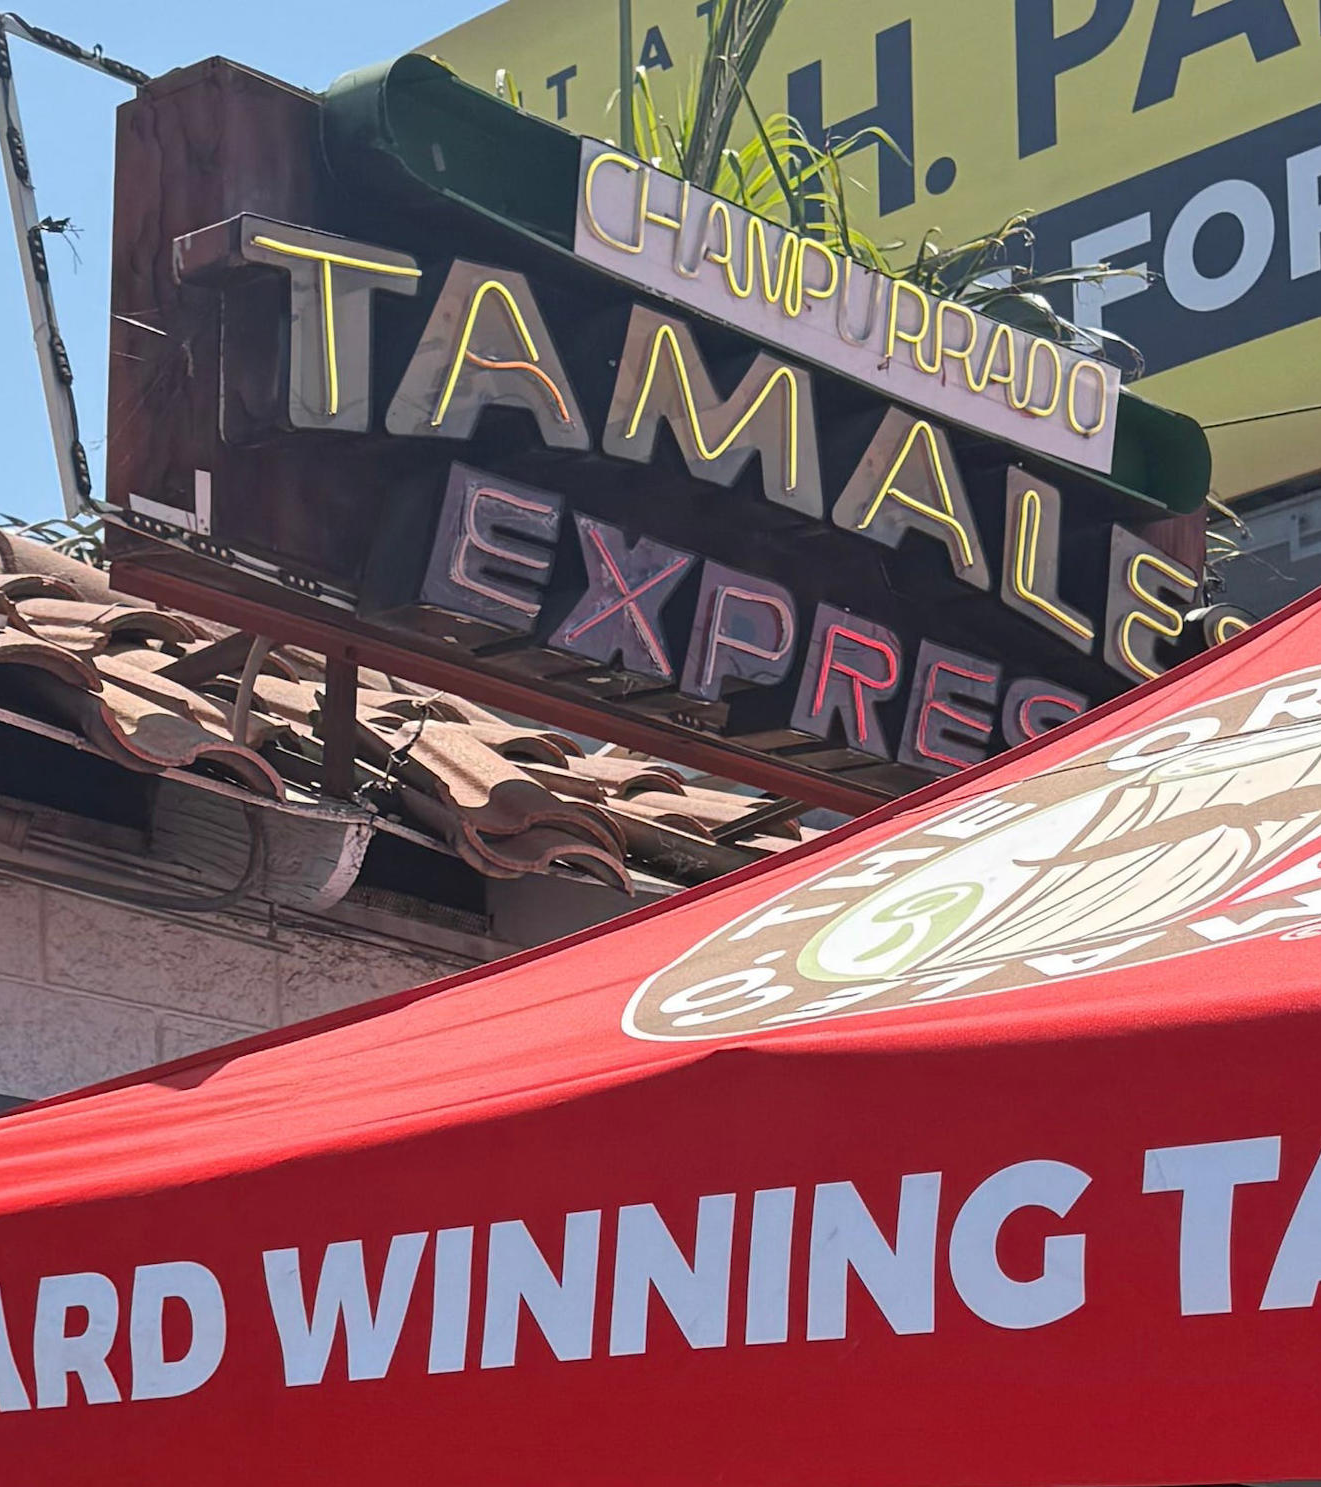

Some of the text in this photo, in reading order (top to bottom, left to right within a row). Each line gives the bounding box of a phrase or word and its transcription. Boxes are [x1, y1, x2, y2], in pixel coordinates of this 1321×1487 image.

[584, 151, 1108, 438] CHAMPURRADO
[419, 461, 1090, 778] EXPRES
[728, 782, 1040, 942] THE
[261, 1159, 1094, 1388] WINNING
